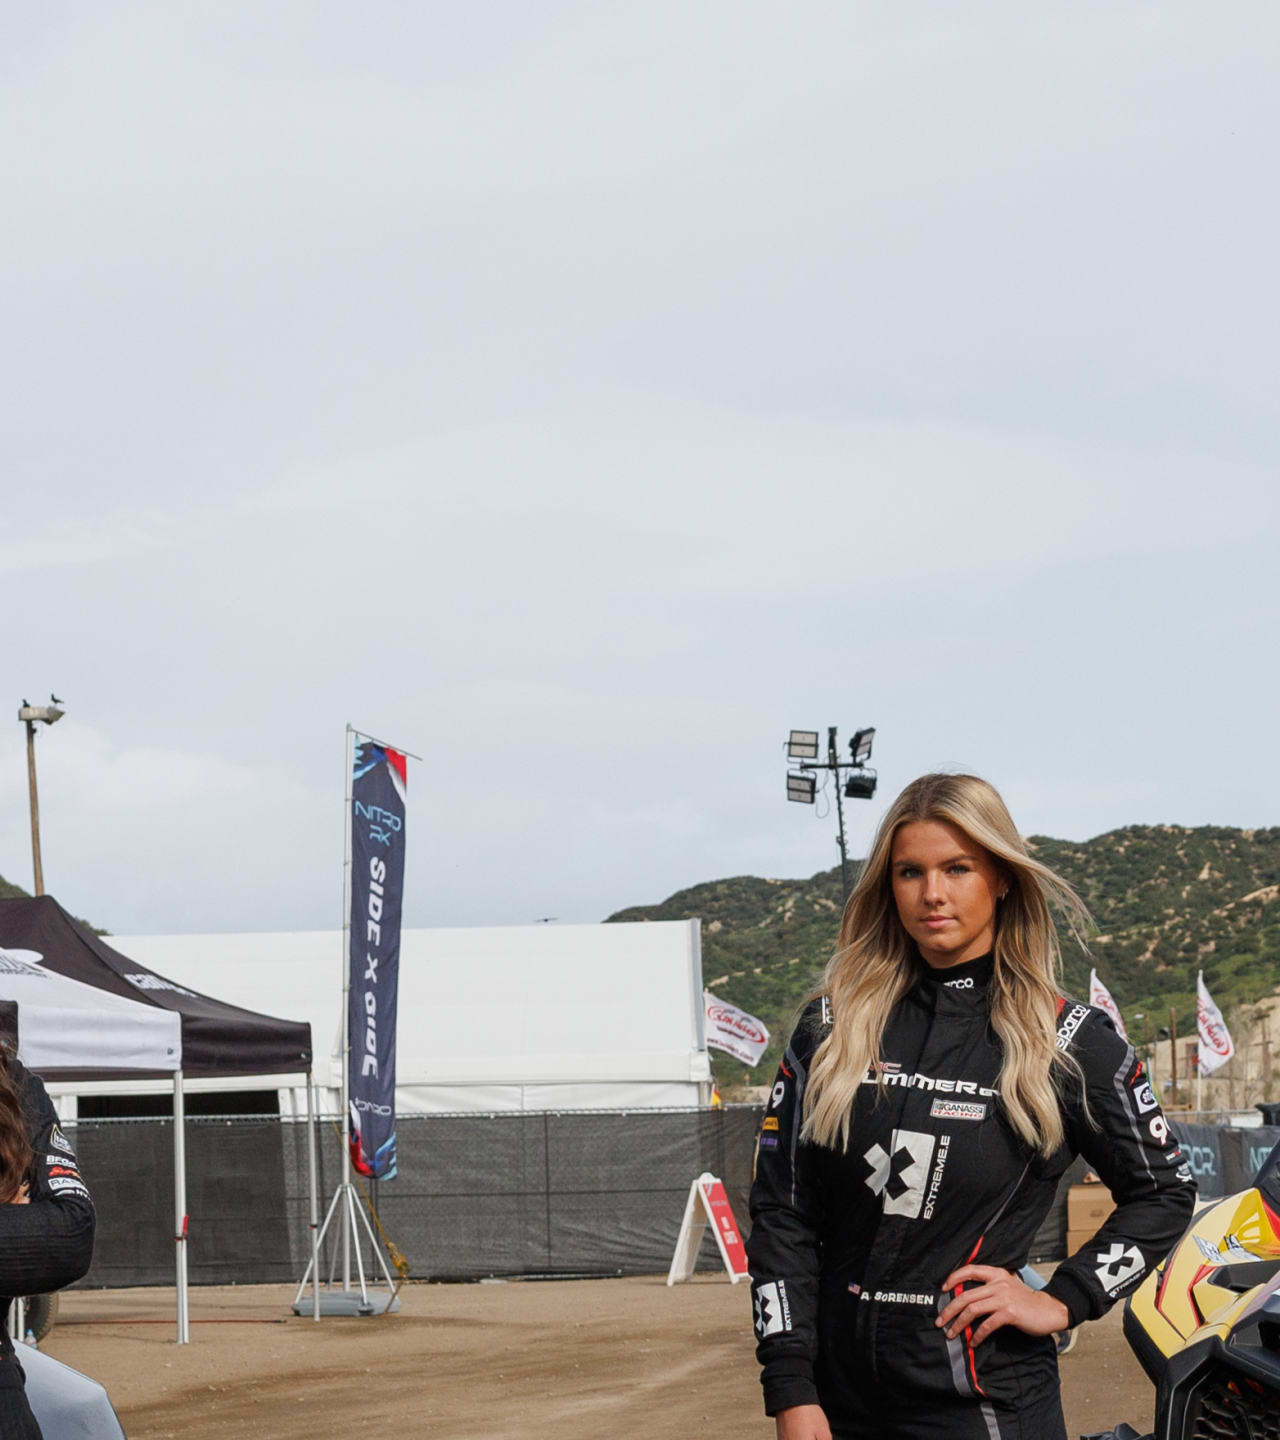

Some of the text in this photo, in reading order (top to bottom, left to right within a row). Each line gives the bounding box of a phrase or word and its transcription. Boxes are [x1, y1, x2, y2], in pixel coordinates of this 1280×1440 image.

[354, 800, 402, 832] NITRO
[369, 824, 391, 846] RX
[367, 856, 386, 946] SIDE
[364, 952, 379, 984] X
[1055, 1004, 1091, 1051] sparco
[933, 1109, 982, 1120] RACING
[923, 1135, 951, 1220] EXTREME.E
